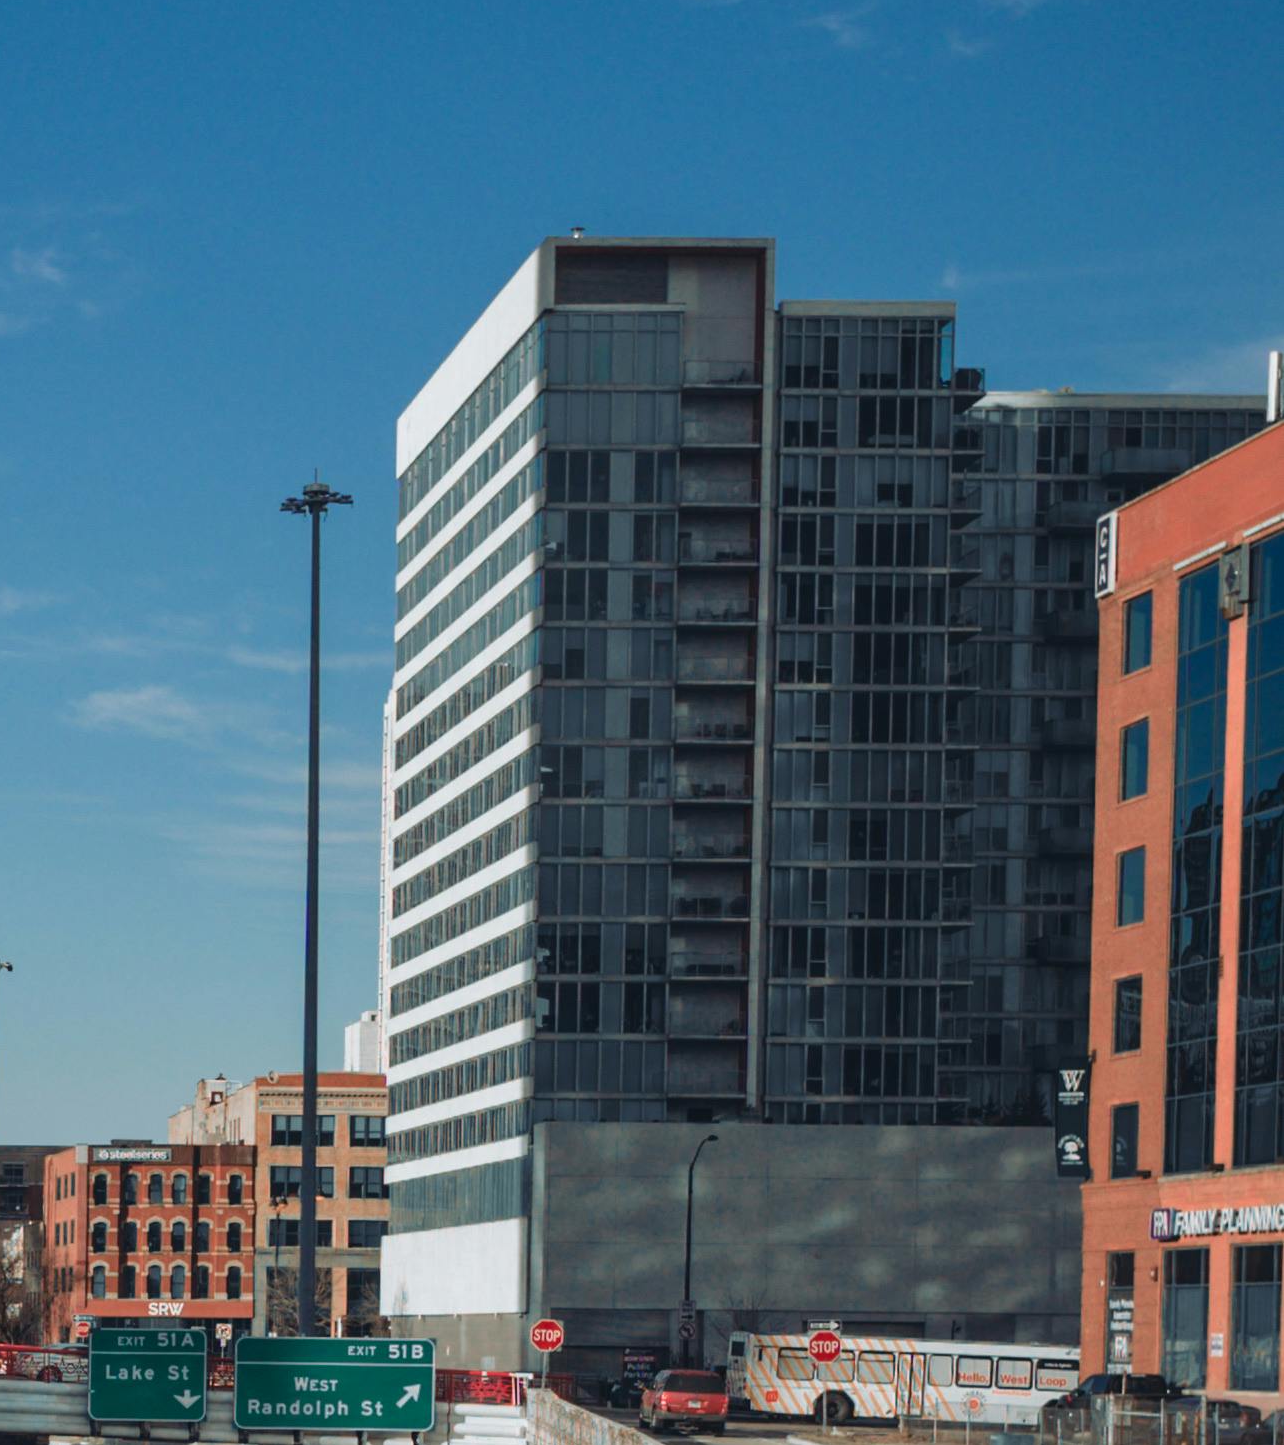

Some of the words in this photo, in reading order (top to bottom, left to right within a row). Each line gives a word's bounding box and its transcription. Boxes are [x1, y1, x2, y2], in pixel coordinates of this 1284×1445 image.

[110, 1149, 169, 1160] steelseries
[1174, 1209, 1216, 1236] FAMILY
[148, 1302, 184, 1316] SRW
[117, 1336, 146, 1347] EXIT
[533, 1329, 561, 1342] STOP
[347, 1345, 377, 1357] EXIT
[811, 1341, 839, 1354] STOP
[105, 1364, 155, 1381] Lake
[167, 1365, 190, 1381] St
[294, 1376, 339, 1393] WEST
[959, 1372, 990, 1384] Hello,
[1000, 1374, 1027, 1385] West
[1039, 1376, 1067, 1388] Loop
[247, 1398, 349, 1419] Randolph
[360, 1399, 383, 1417] St
